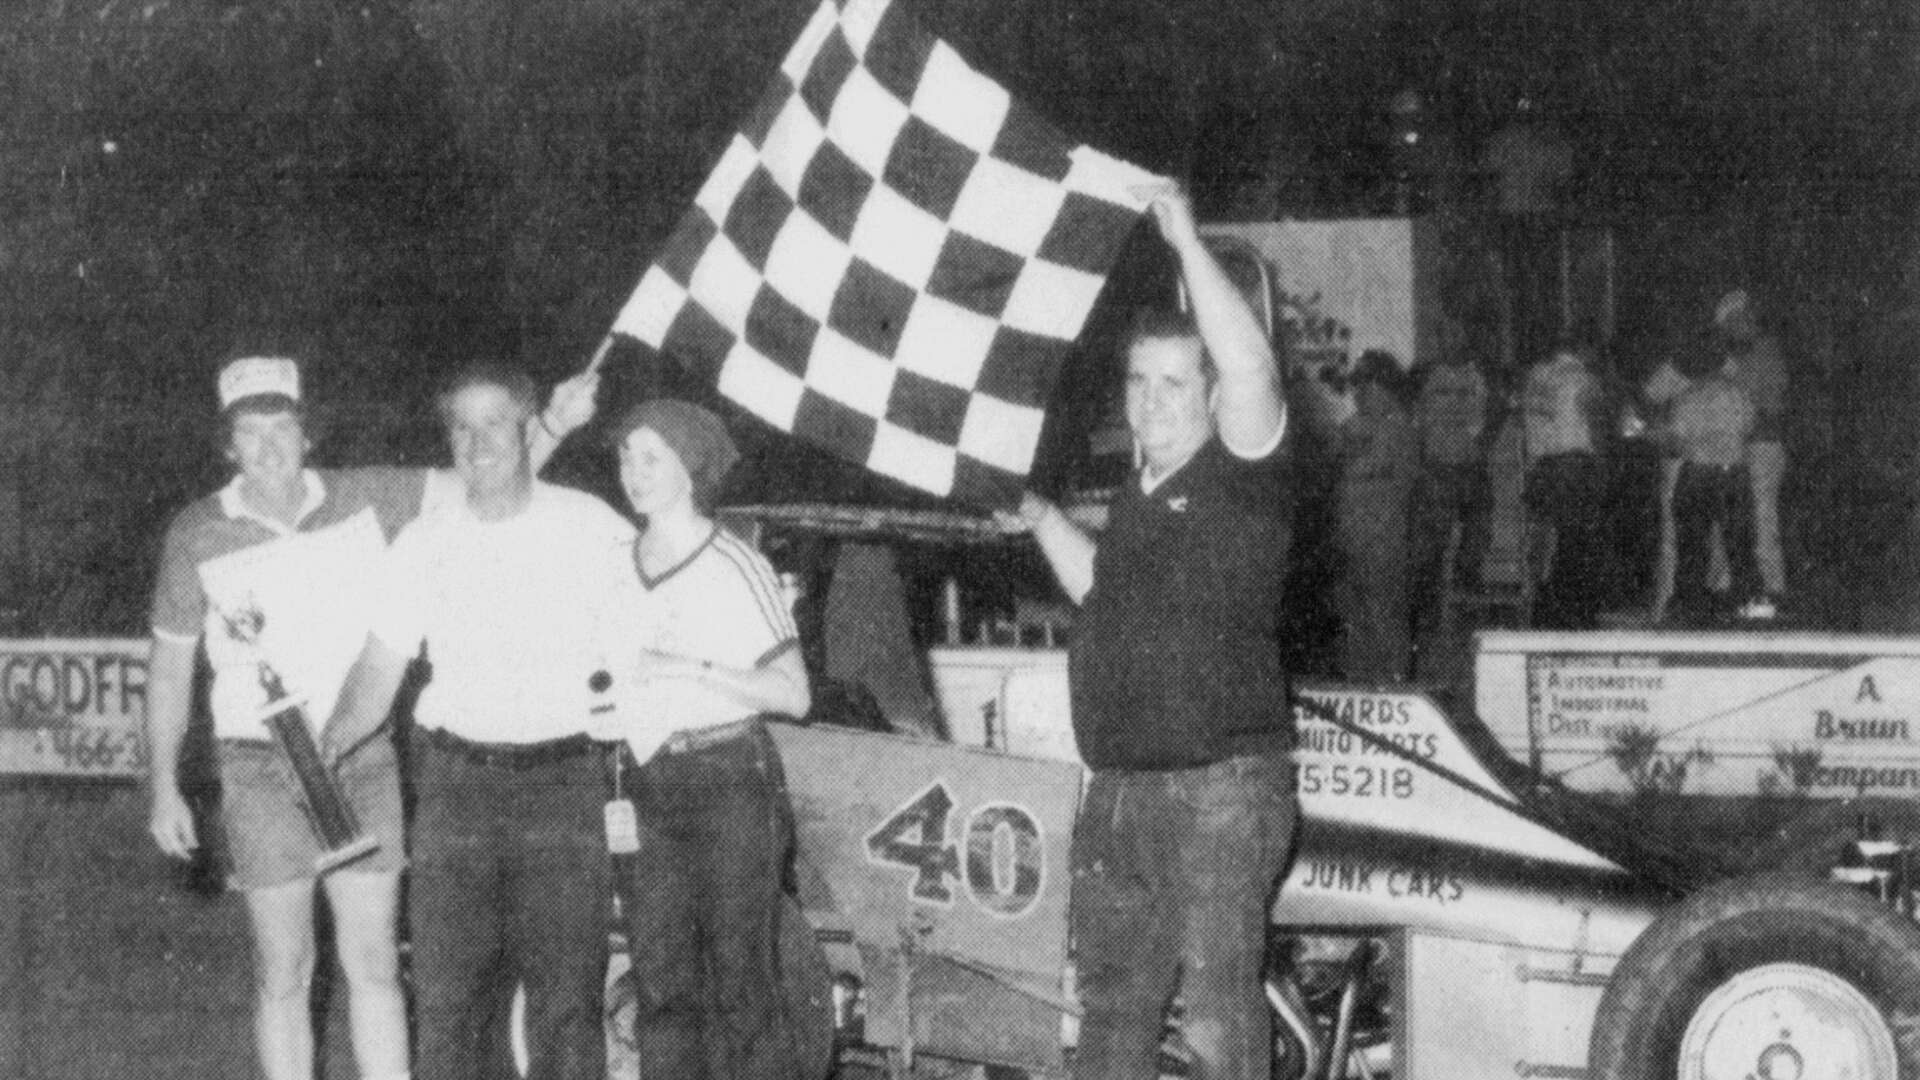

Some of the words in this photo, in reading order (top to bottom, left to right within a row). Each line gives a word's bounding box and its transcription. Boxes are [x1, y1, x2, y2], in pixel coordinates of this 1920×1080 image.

[1855, 673, 1881, 703] A
[1815, 708, 1909, 740] Braun
[1812, 766, 1919, 794] ompan
[862, 777, 1047, 920] 40
[1302, 861, 1374, 893] JUNK
[1387, 868, 1465, 903] CARS
